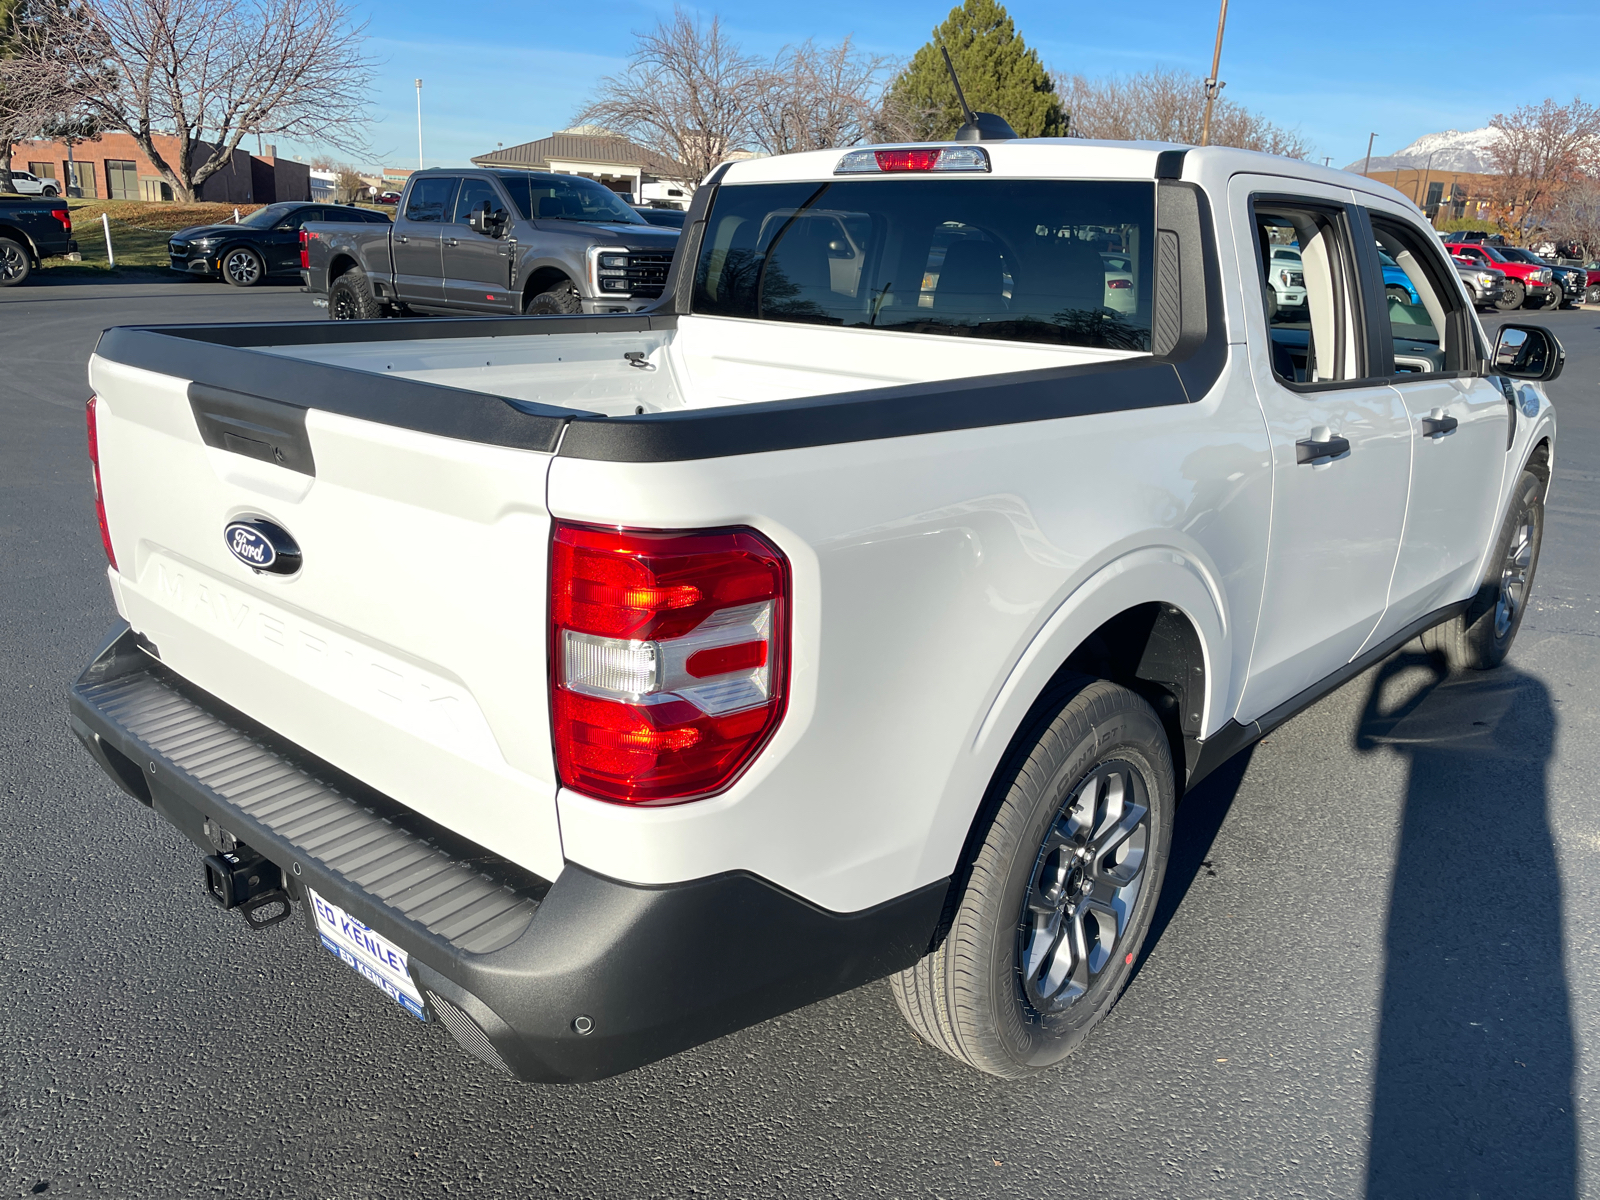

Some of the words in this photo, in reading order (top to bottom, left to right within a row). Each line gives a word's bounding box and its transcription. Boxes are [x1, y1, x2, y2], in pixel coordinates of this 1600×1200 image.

[233, 529, 264, 562] Ford
[315, 897, 336, 927] ED
[340, 948, 356, 969] ED
[357, 960, 400, 1003] KENLEY
